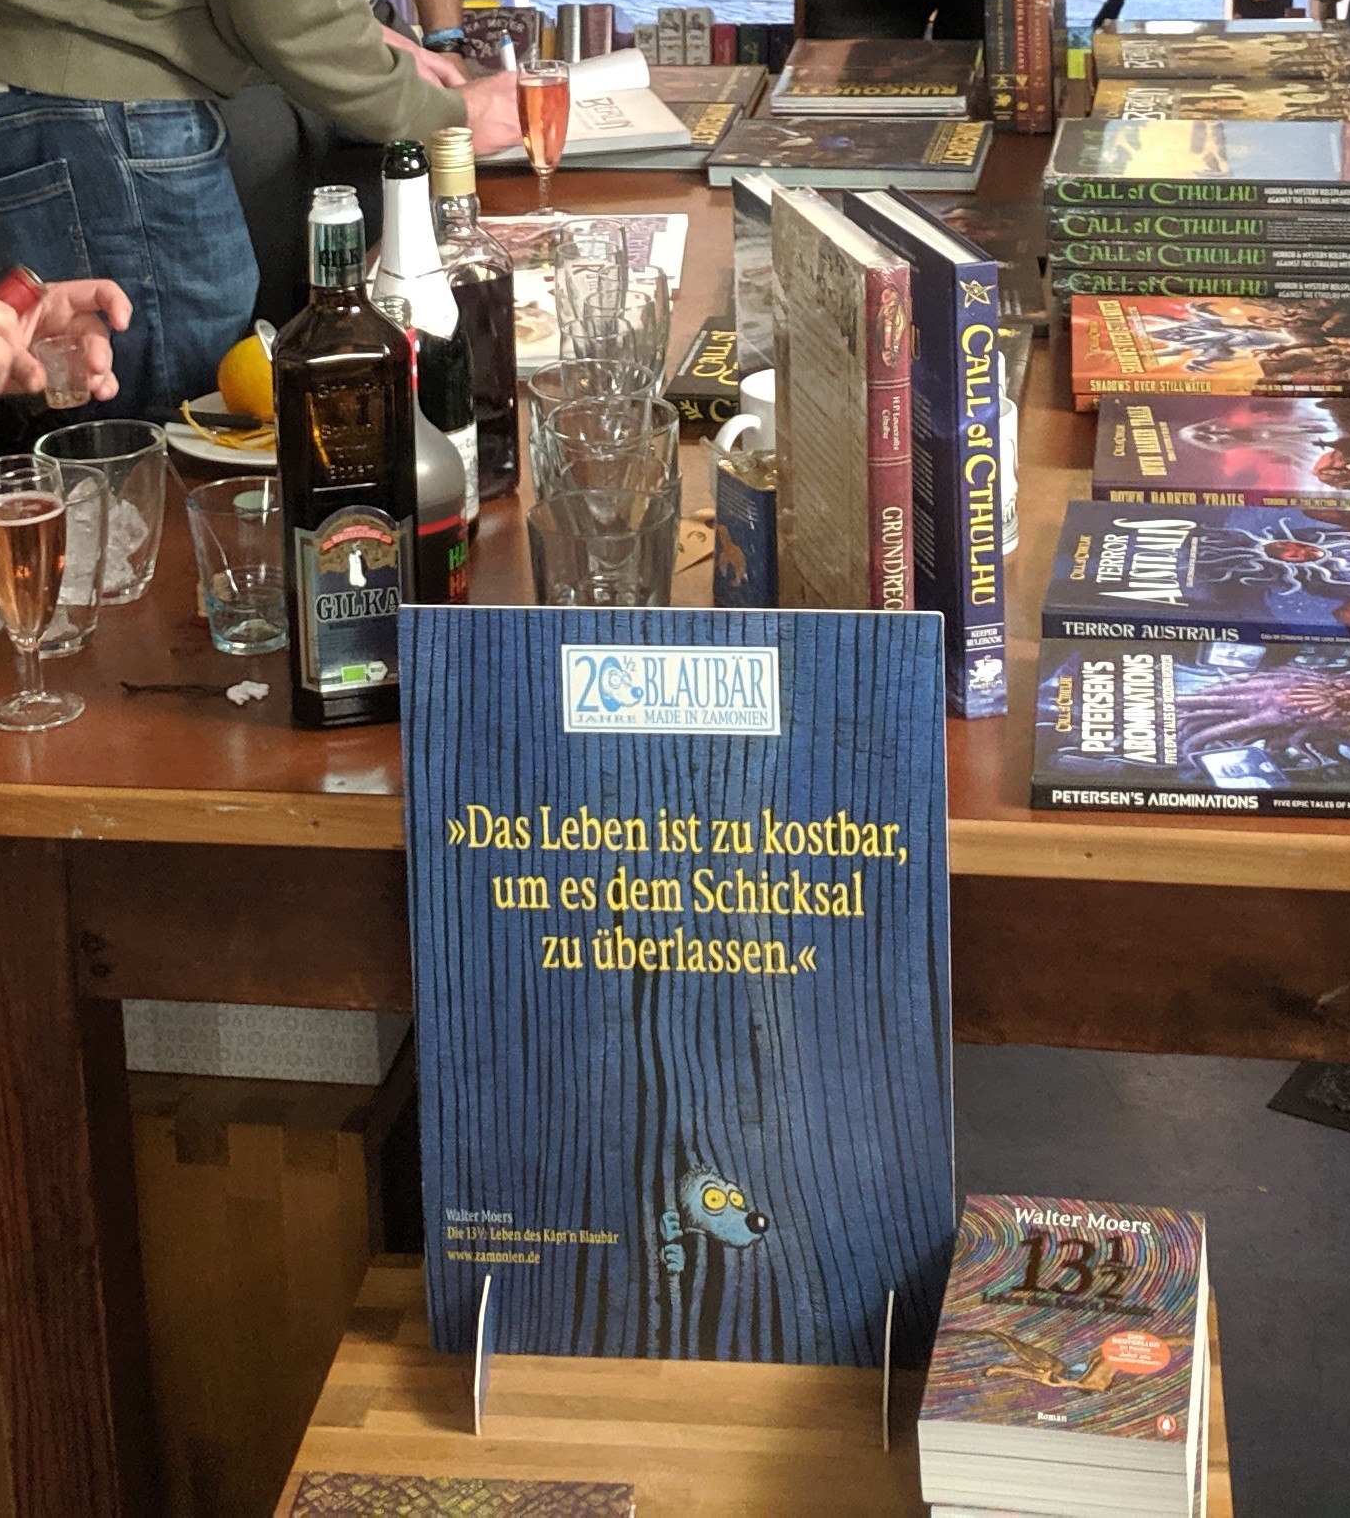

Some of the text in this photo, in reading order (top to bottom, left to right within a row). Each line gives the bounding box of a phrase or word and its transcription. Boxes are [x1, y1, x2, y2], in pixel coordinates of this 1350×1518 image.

[1057, 181, 1258, 205] CALL of CTHULHU
[1063, 214, 1129, 237] CALL
[1133, 216, 1150, 233] of
[1154, 216, 1264, 238] CTHULHU
[1064, 241, 1267, 267] CALL of CTHULHU
[1068, 272, 1268, 297] CALL of CTHULHU
[1090, 380, 1212, 393] SHADOWS OVER STILLWATER
[960, 323, 996, 607] CALL of CTHULHU
[1202, 492, 1245, 507] TRAILS
[1096, 533, 1129, 584] TERROR
[1098, 517, 1198, 607] AUSTRALIS
[1062, 620, 1239, 642] TERROR AUSTRALIS
[644, 654, 767, 709] BLAUBÄR
[576, 712, 637, 725] JAHRE
[644, 709, 768, 726] MADE IN ZAMONIEN
[1081, 661, 1114, 752] PETERSEN'S
[1122, 654, 1157, 764] ABOMINATIONS
[1051, 789, 1259, 810] PETERSEN'S ABOMINATIONS
[1310, 800, 1334, 809] TALES
[1336, 801, 1346, 809] OF
[447, 804, 909, 866] »Das Leben ist zu kostbar,
[493, 868, 866, 919] um es dem Schicksal
[541, 926, 818, 976] zu überlassen.«
[446, 1208, 513, 1223] Walter Moers
[1014, 1208, 1151, 1234] Walter Moers
[490, 1227, 521, 1241] Leben
[523, 1229, 541, 1241] des
[1037, 1412, 1067, 1422] Roman
